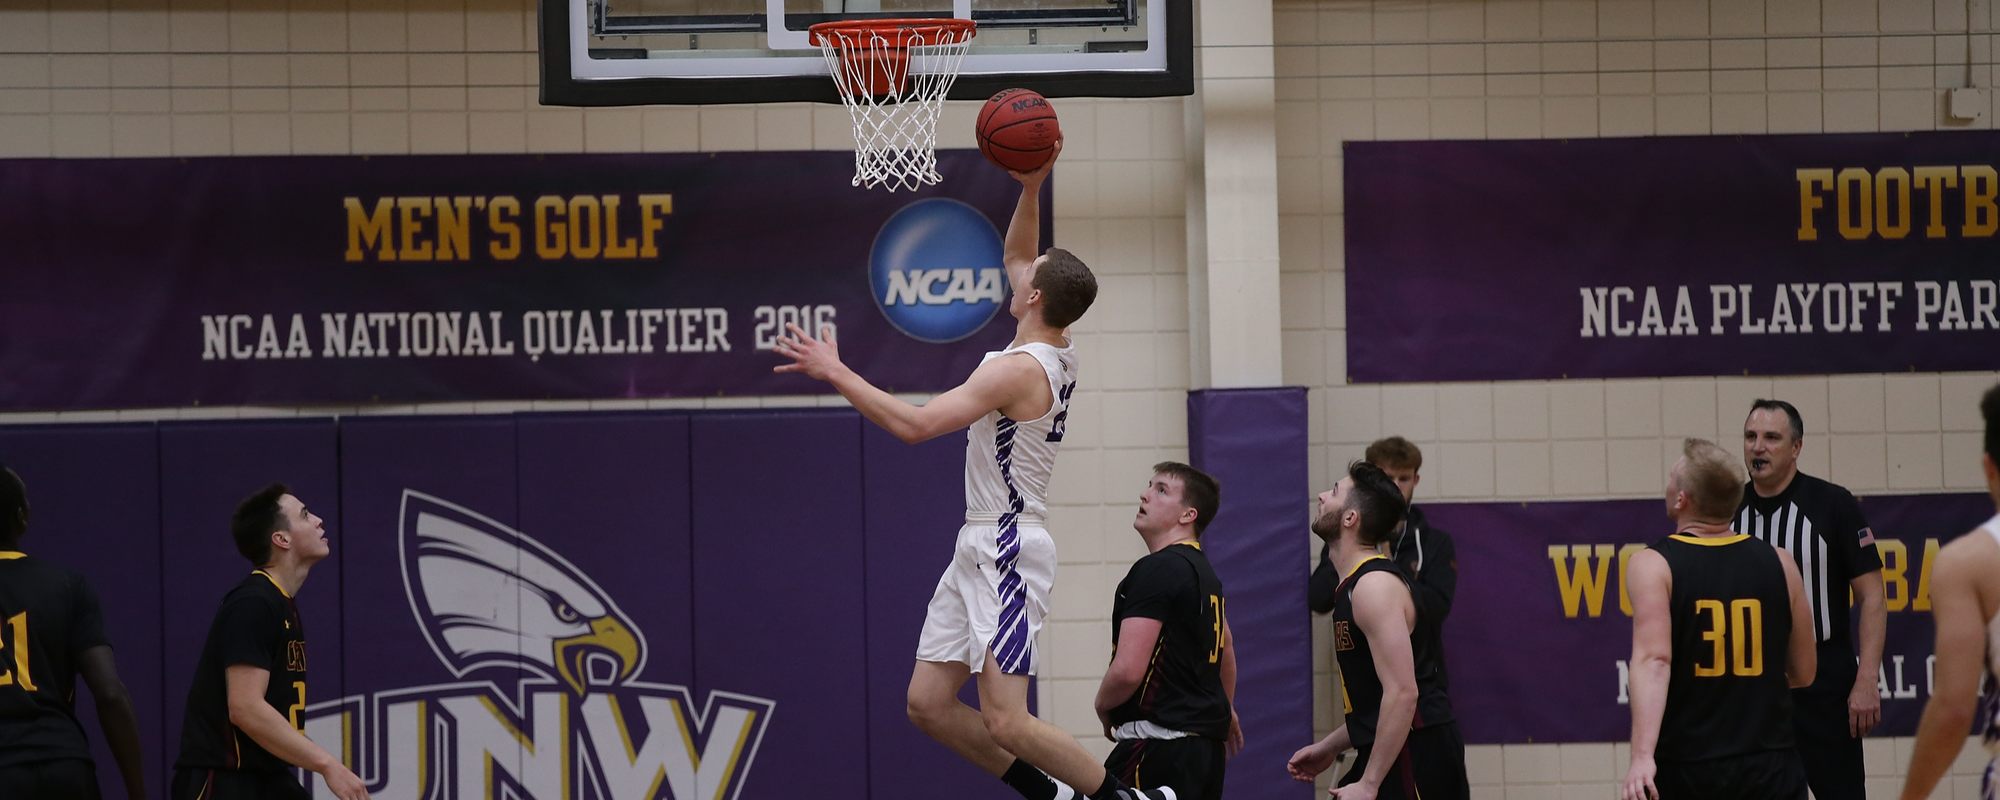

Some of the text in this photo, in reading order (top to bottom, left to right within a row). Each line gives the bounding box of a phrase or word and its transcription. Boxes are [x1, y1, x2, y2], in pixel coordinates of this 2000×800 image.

[1011, 97, 1048, 114] NCAA
[344, 193, 673, 262] MEN'S GOLF
[884, 267, 1004, 306] NCAA
[1580, 285, 1699, 337] NCAA
[1710, 282, 1903, 336] PLAYOFF
[201, 303, 838, 362] NCAA NATIONAL QUALIFIER 2016
[1694, 598, 1764, 677] 30
[303, 680, 776, 800] UNW
